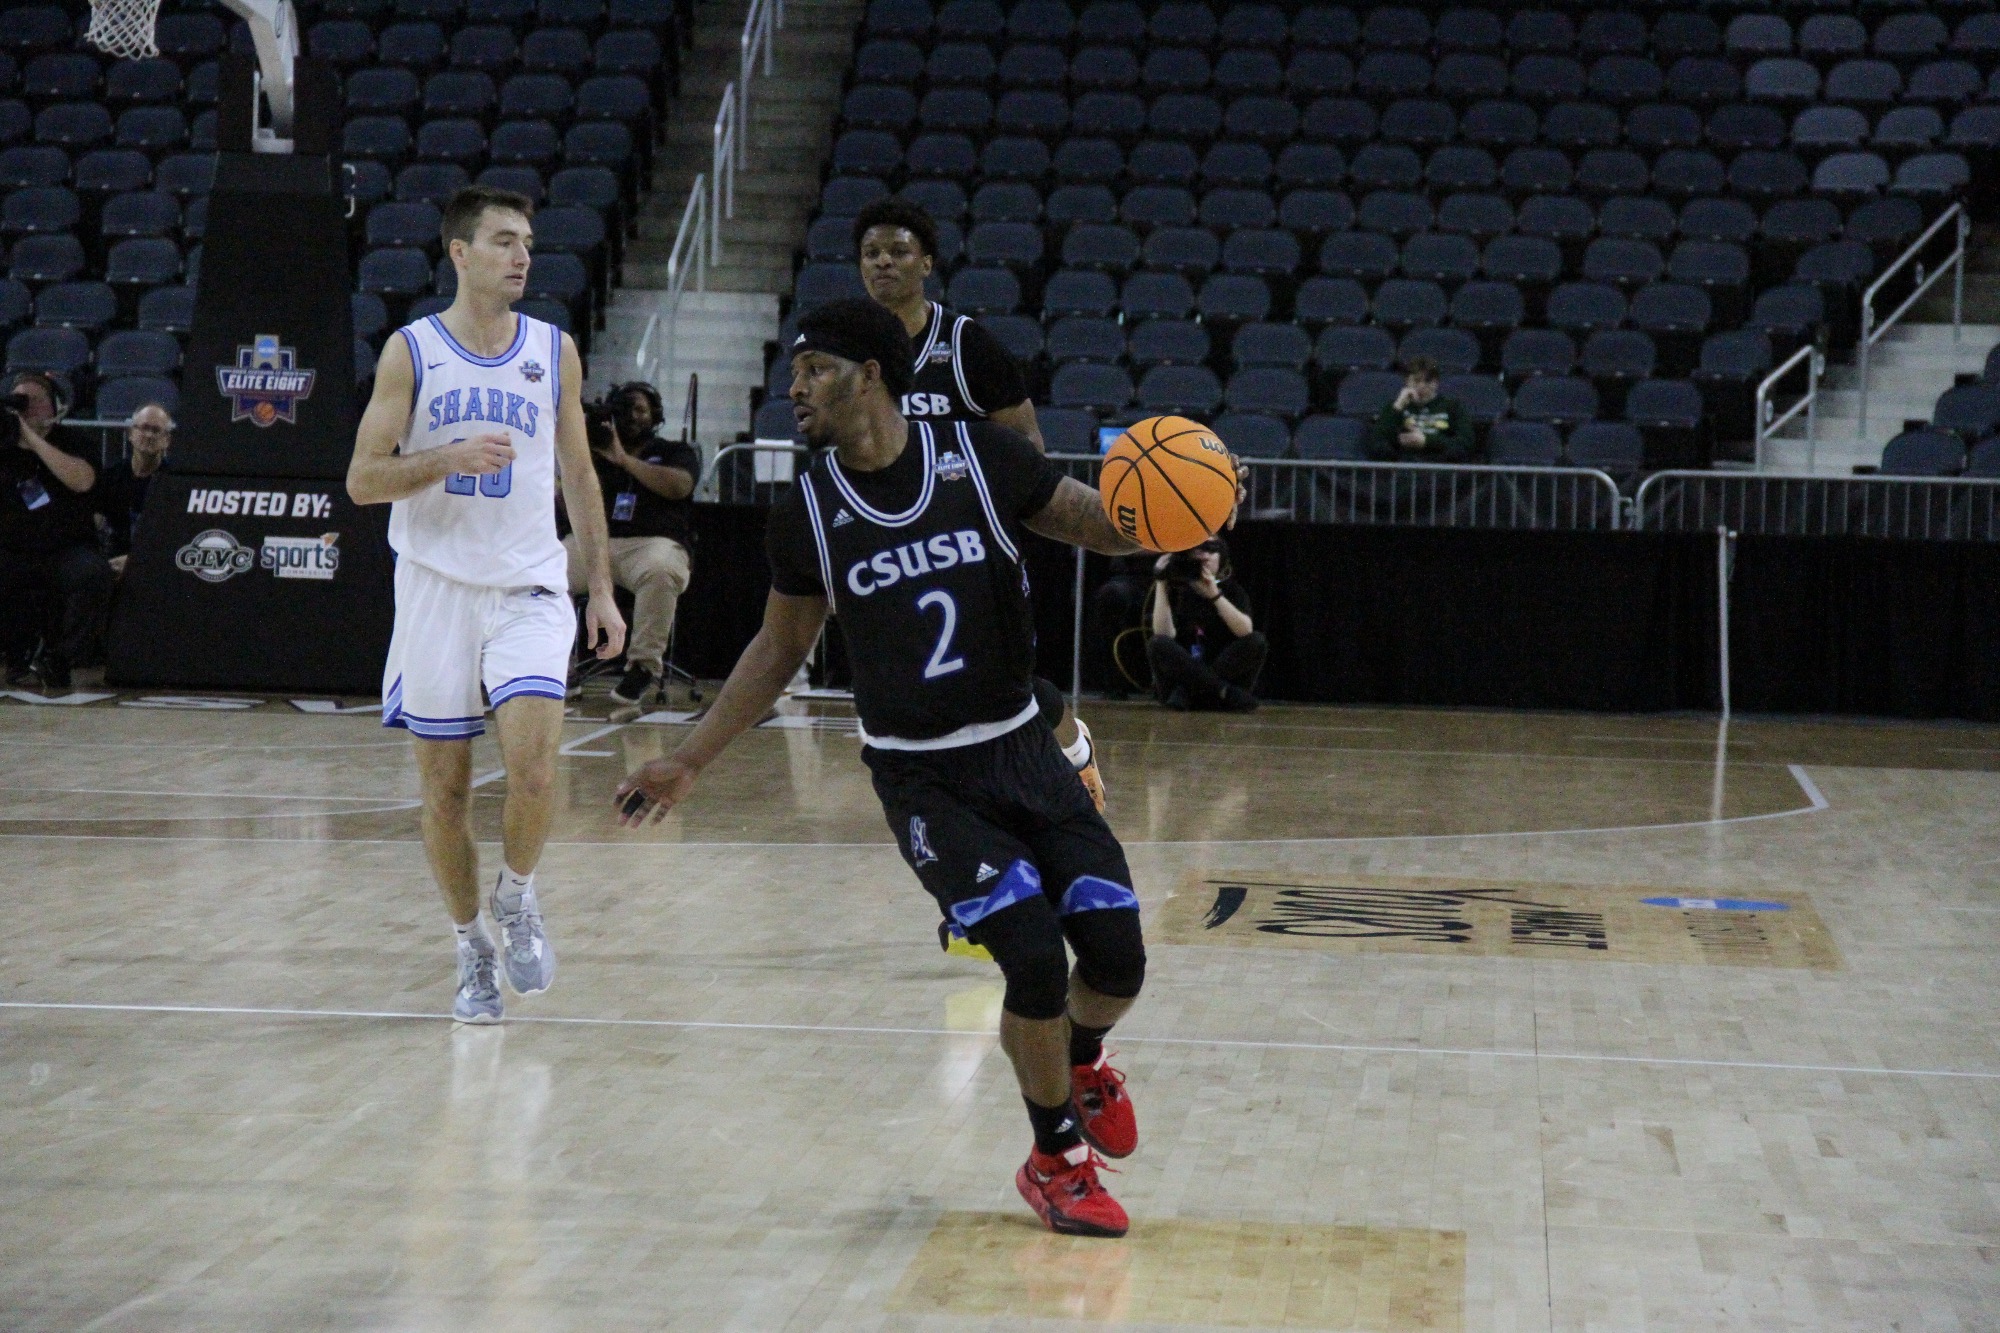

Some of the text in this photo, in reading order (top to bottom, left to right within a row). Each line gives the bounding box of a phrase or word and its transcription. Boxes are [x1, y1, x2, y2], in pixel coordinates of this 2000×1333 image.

[227, 374, 306, 392] ELITE EIGHT
[428, 387, 539, 438] SHARKS
[187, 489, 332, 518] HOSTED BY:
[177, 547, 252, 571] GLVC
[261, 544, 339, 575] sports
[847, 530, 986, 596] CSUSB
[917, 590, 965, 680] 2
